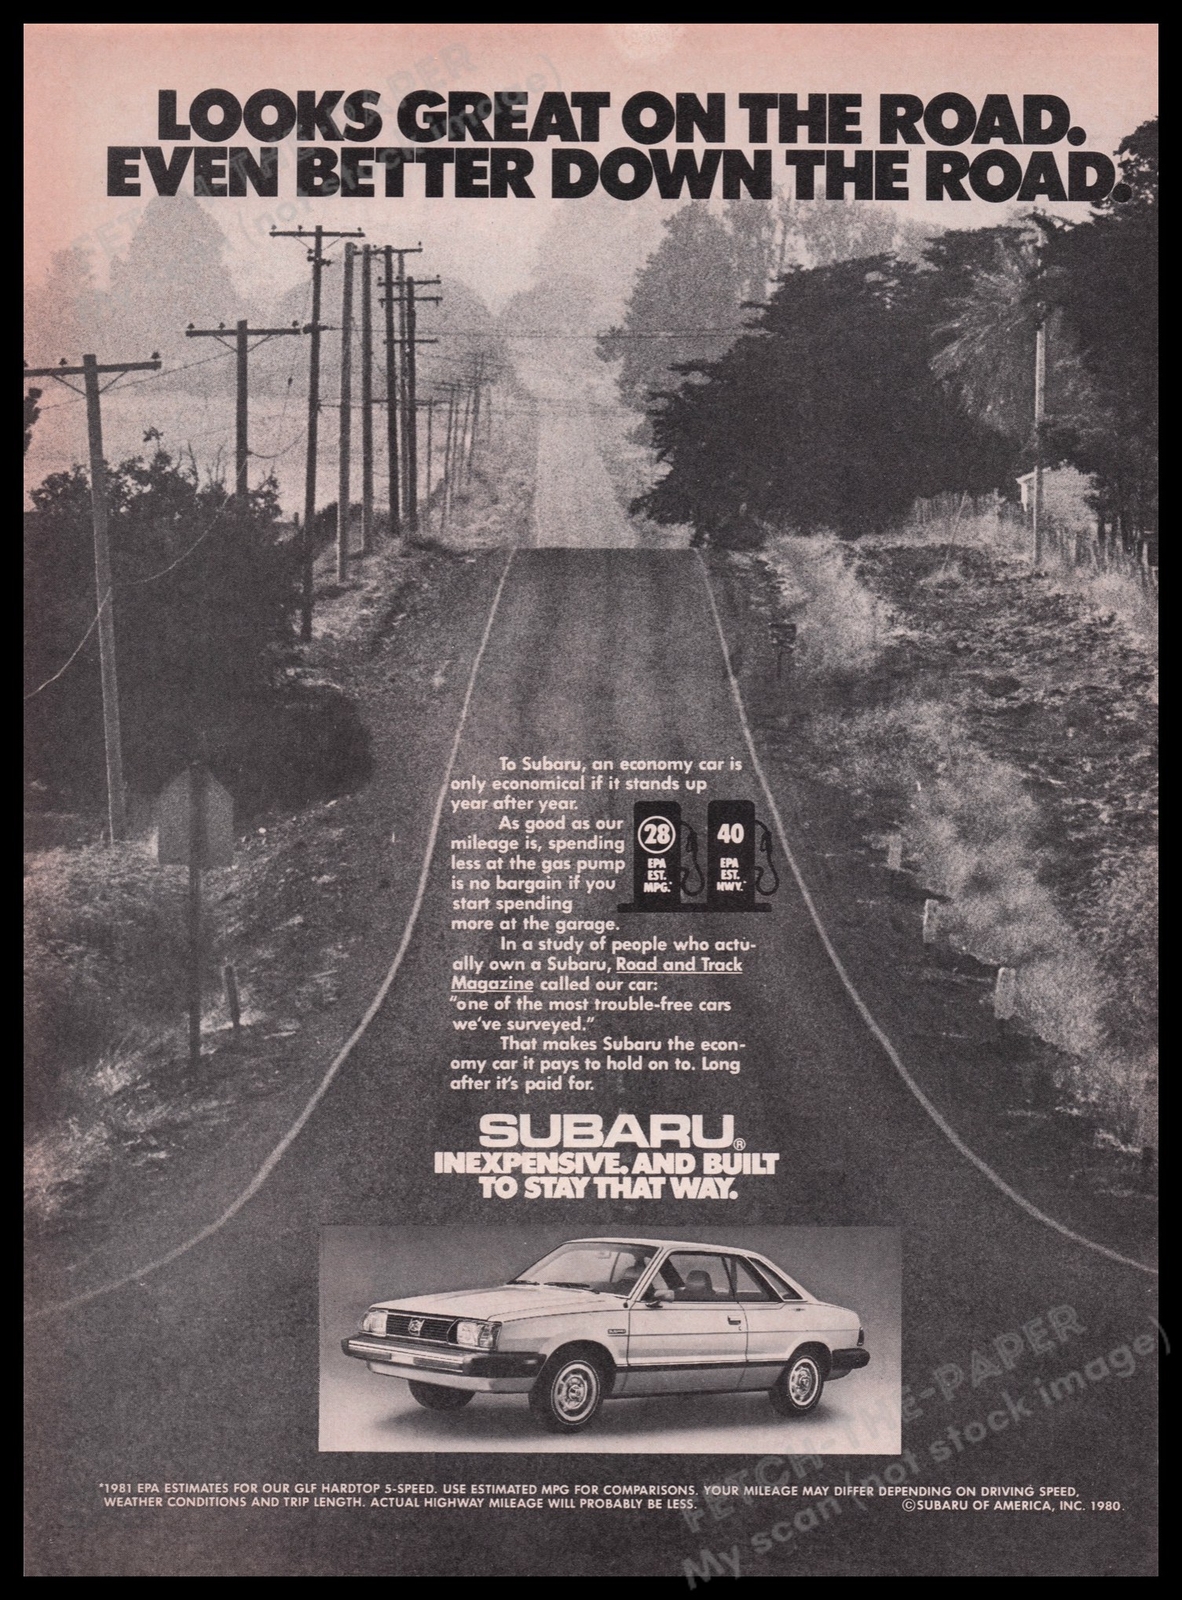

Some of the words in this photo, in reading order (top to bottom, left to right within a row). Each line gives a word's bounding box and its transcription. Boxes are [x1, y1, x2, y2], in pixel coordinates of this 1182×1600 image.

[158, 88, 383, 142] LOOKS
[397, 90, 610, 142] GREAT
[622, 91, 725, 145] ON
[739, 92, 862, 144] THE
[880, 92, 1087, 146] ROAD.
[107, 146, 278, 197] EVEN
[297, 147, 535, 198] BETTER
[552, 146, 772, 201] DOWN
[786, 149, 909, 201] THE
[926, 149, 1132, 203] ROAD.
[499, 756, 516, 771] To
[522, 756, 586, 773] Subaru,
[592, 760, 613, 770] an
[620, 760, 693, 774] economy
[699, 761, 724, 770] car
[730, 756, 742, 771] is
[451, 776, 486, 794] only
[492, 775, 585, 790] economical
[591, 775, 603, 790] if
[609, 776, 620, 790] it
[625, 775, 679, 790] stands
[686, 780, 707, 794] up
[451, 799, 488, 813] year
[492, 794, 534, 810] after
[538, 800, 578, 813] year.
[498, 815, 520, 830] As
[525, 814, 565, 833] good
[571, 820, 590, 830] as
[596, 820, 624, 830] our
[644, 823, 671, 844] 28
[717, 823, 744, 844] 40
[451, 834, 519, 853] mileage
[525, 835, 542, 852] is,
[548, 835, 624, 853] spending
[451, 854, 481, 870] less
[486, 857, 504, 870] at
[509, 854, 536, 870] the
[542, 860, 571, 874] gas
[577, 860, 625, 874] pump
[647, 858, 667, 869] EPA
[720, 857, 739, 868] EPA
[452, 875, 464, 890] is
[469, 880, 490, 890] no
[496, 875, 562, 893] bargain
[569, 874, 580, 889] if
[586, 880, 615, 894] you
[647, 870, 667, 881] EST.
[720, 869, 741, 880] EST.
[453, 897, 490, 910] start
[496, 895, 572, 914] spending
[451, 920, 494, 930] more
[500, 918, 517, 930] at
[523, 915, 549, 930] the
[555, 920, 619, 934] garage.
[501, 936, 516, 950] In
[522, 941, 533, 950] a
[538, 936, 584, 955] study
[590, 935, 606, 951] of
[612, 935, 667, 954] people
[673, 935, 709, 951] who
[453, 955, 484, 974] ally
[489, 961, 525, 970] own
[531, 961, 541, 971] a
[547, 956, 611, 973] Subaru,
[616, 956, 657, 971] Road
[663, 956, 695, 971] and
[701, 956, 742, 971] Track
[451, 975, 534, 993] Magazine
[540, 975, 590, 991] called
[596, 981, 624, 991] our
[628, 981, 658, 991] car:
[494, 995, 511, 1010] of
[516, 995, 543, 1011] the
[549, 998, 589, 1011] most
[594, 996, 693, 1011] trouble-free
[699, 1001, 731, 1011] cars
[500, 1035, 537, 1050] That
[543, 1035, 597, 1050] makes
[603, 1036, 661, 1050] Subaru
[667, 1036, 695, 1051] the
[451, 1060, 486, 1073] omy
[492, 1060, 518, 1070] car
[523, 1056, 535, 1070] it
[540, 1060, 579, 1074] pays
[585, 1058, 601, 1070] to
[607, 1055, 642, 1070] hold
[648, 1061, 668, 1070] on
[675, 1058, 695, 1070] to.
[702, 1056, 740, 1074] Long
[450, 1075, 491, 1090] after
[525, 1075, 562, 1094] paid
[568, 1075, 594, 1090] for.
[434, 1152, 629, 1175] INEXPENSIVE.
[631, 1153, 696, 1175] AND
[703, 1153, 780, 1175] BUILT
[479, 1176, 518, 1199] TO
[524, 1176, 590, 1199] STAY
[593, 1177, 666, 1199] THAT
[669, 1177, 739, 1200] WAY.
[137, 1483, 160, 1493] EPA
[164, 1483, 228, 1493] ESTIMATES
[234, 1483, 258, 1493] FOR
[262, 1483, 289, 1493] OUR
[294, 1483, 317, 1493] GLF
[322, 1483, 380, 1493] HARDTOP
[385, 1484, 437, 1494] 5-SPEED.
[443, 1484, 466, 1494] USE
[471, 1484, 537, 1494] ESTIMATED
[541, 1485, 569, 1495] MPG
[575, 1485, 598, 1495] FOR
[603, 1485, 698, 1495] COMPARISONS.
[704, 1485, 739, 1496] YOUR
[744, 1486, 798, 1496] MILEAGE
[802, 1486, 829, 1496] MAY
[834, 1486, 874, 1496] DIFFER
[879, 1486, 951, 1496] DEPENDING
[956, 1486, 976, 1496] ON
[981, 1487, 1034, 1497] DRIVING
[1039, 1487, 1079, 1497] SPEED,
[104, 1497, 163, 1507] WEATHER
[167, 1497, 247, 1507] CONDITIONS
[251, 1497, 279, 1507] AND
[283, 1497, 309, 1507] TRIP
[314, 1497, 365, 1507] LENGTH.
[370, 1497, 420, 1507] ACTUAL
[424, 1498, 484, 1508] HIGHWAY
[489, 1498, 543, 1508] MILEAGE
[548, 1498, 575, 1508] WILL
[580, 1498, 642, 1509] PROBABLY
[648, 1499, 662, 1509] BE
[667, 1499, 697, 1509] LESS.
[973, 1500, 989, 1510] OF
[994, 1500, 1055, 1512] AMERICA,
[1060, 1501, 1085, 1511] INC.
[1091, 1501, 1124, 1511] 1980.
